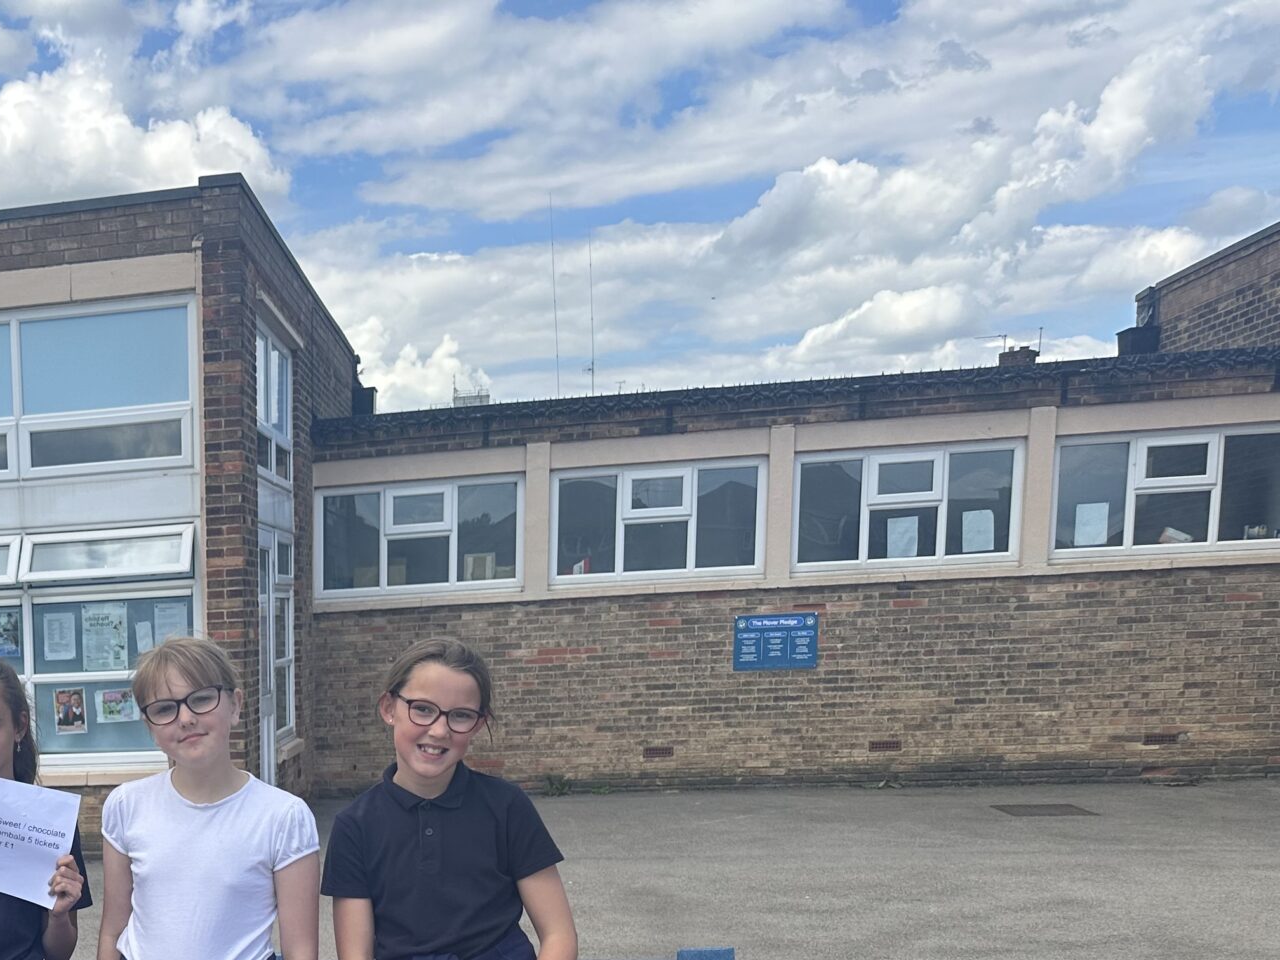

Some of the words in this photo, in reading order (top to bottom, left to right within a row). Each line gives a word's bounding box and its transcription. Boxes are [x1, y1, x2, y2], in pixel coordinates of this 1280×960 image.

[27, 824, 66, 839] chocolate
[4, 841, 14, 849] £1
[27, 834, 33, 844] 5
[34, 838, 60, 850] tickets
